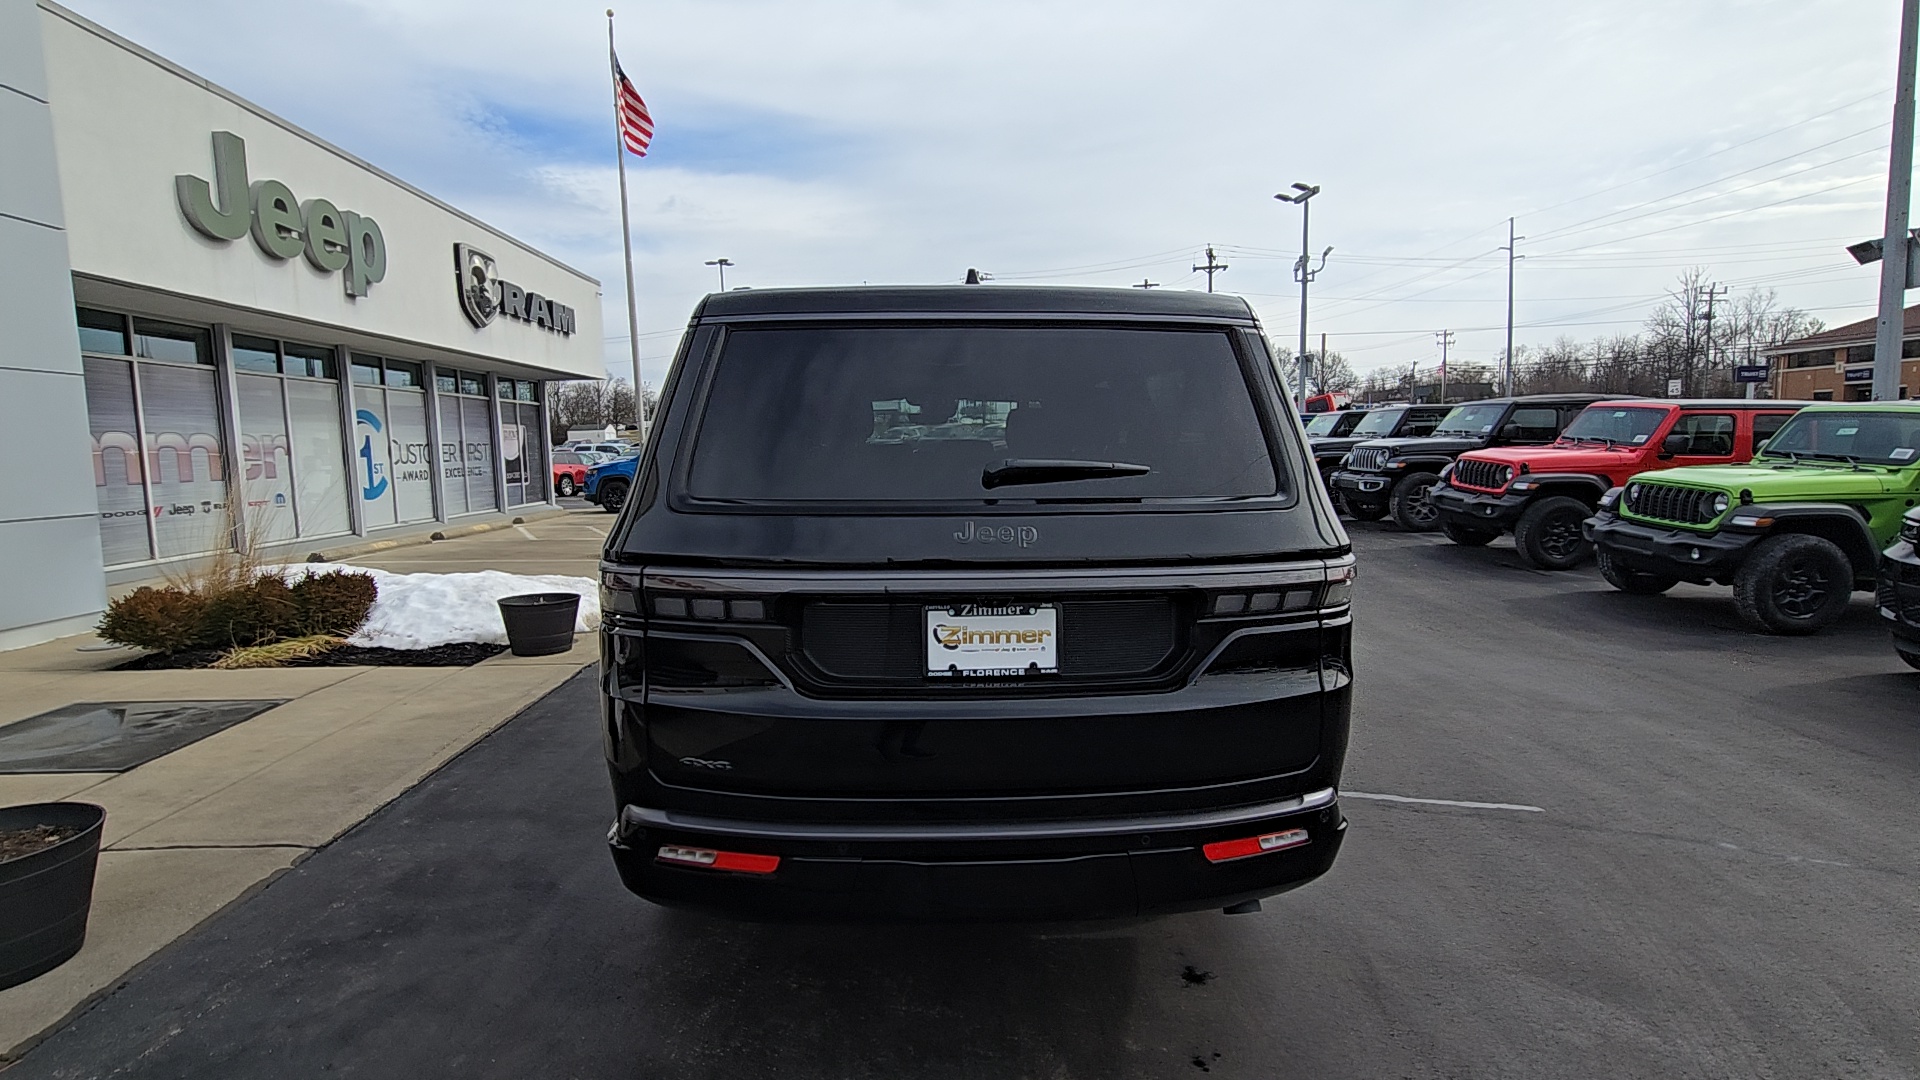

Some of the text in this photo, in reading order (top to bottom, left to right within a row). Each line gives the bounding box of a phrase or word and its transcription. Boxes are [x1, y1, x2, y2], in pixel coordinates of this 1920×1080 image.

[175, 130, 387, 299] Jeep
[499, 279, 577, 335] RAM
[390, 438, 458, 466] CUSTOER
[401, 465, 484, 482] AWARD EXCELENCE
[102, 509, 150, 519] DODG
[168, 503, 195, 517] Jeep
[953, 521, 1038, 548] Jeep
[960, 603, 1024, 616] Zimmer
[941, 625, 1052, 646] Zimmer
[962, 668, 1026, 677] FLORENCE
